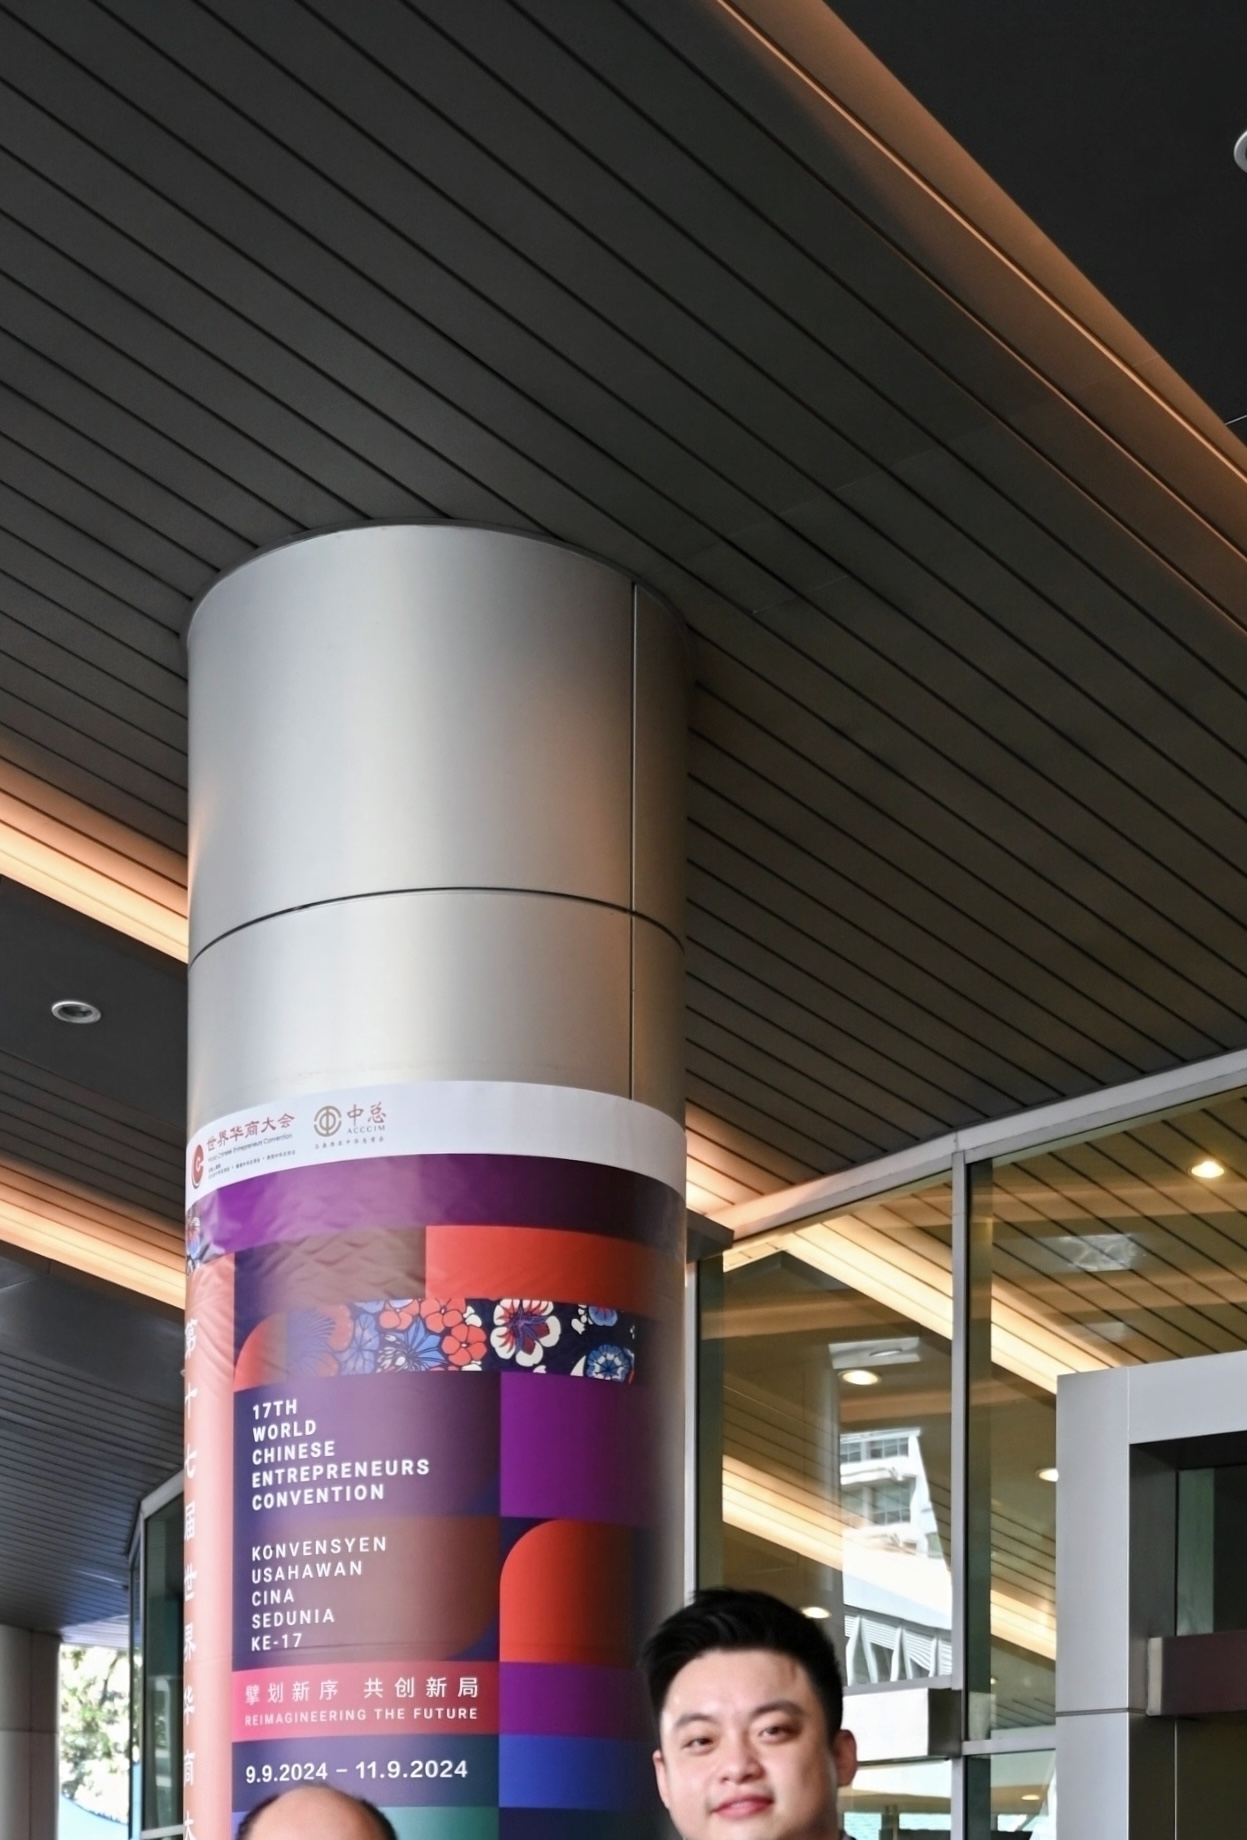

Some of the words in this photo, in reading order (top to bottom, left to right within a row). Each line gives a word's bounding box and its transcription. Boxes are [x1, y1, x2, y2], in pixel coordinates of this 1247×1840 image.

[206, 1113, 295, 1152] 世界华商大会
[346, 1125, 386, 1134] ACCCIM
[252, 1398, 297, 1420] 17TH
[252, 1419, 316, 1442] WORLD
[252, 1440, 335, 1465] CHINESE
[252, 1458, 429, 1488] ENTREPRENEURS
[252, 1483, 384, 1511] CONVENTION
[252, 1536, 386, 1561] KONVENSYEN
[252, 1560, 362, 1584] USAHAWAN
[252, 1588, 294, 1606] CINA
[252, 1608, 335, 1629] SEDUNIA
[251, 1632, 302, 1651] KE-17
[363, 1677, 478, 1699] 共创新局
[245, 1709, 367, 1726] REIMAGINEERING
[374, 1708, 405, 1720] THE
[413, 1707, 478, 1720] FUTURE
[245, 1762, 328, 1783] 9.9.2024
[355, 1760, 468, 1778] 11.9.2024
